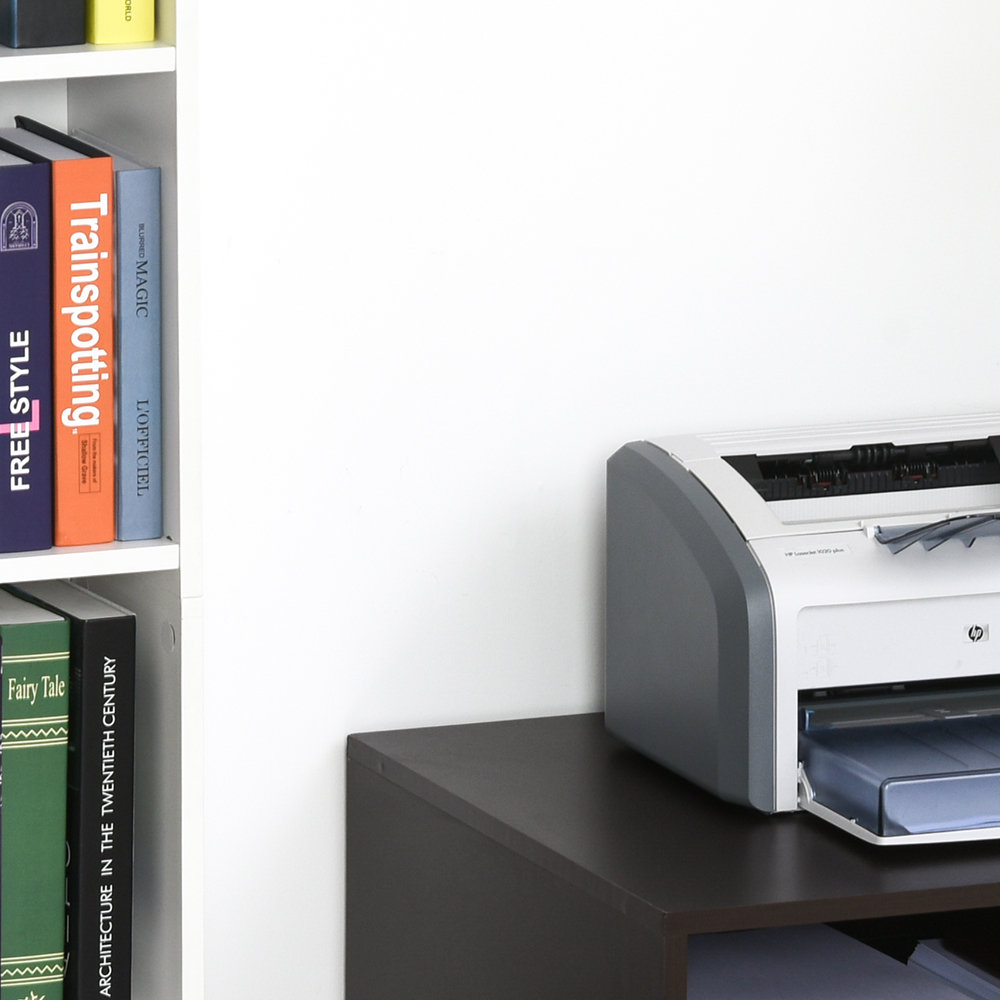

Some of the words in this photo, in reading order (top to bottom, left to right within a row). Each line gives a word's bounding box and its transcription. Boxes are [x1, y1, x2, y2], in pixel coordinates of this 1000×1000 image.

[61, 193, 109, 427] Trainspotting
[136, 260, 148, 318] MAGIC
[10, 330, 30, 414] STYLE
[10, 421, 30, 491] FREE
[137, 400, 150, 497] L'OFFICIEL
[968, 624, 984, 642] hp
[8, 677, 38, 705] Fairy
[41, 674, 66, 699] Tale
[102, 656, 116, 727] CENTURY
[101, 730, 115, 816] TWENTIETH
[101, 823, 114, 853] THE
[101, 859, 113, 876] IN
[99, 884, 113, 998] ARCHITECTURE
